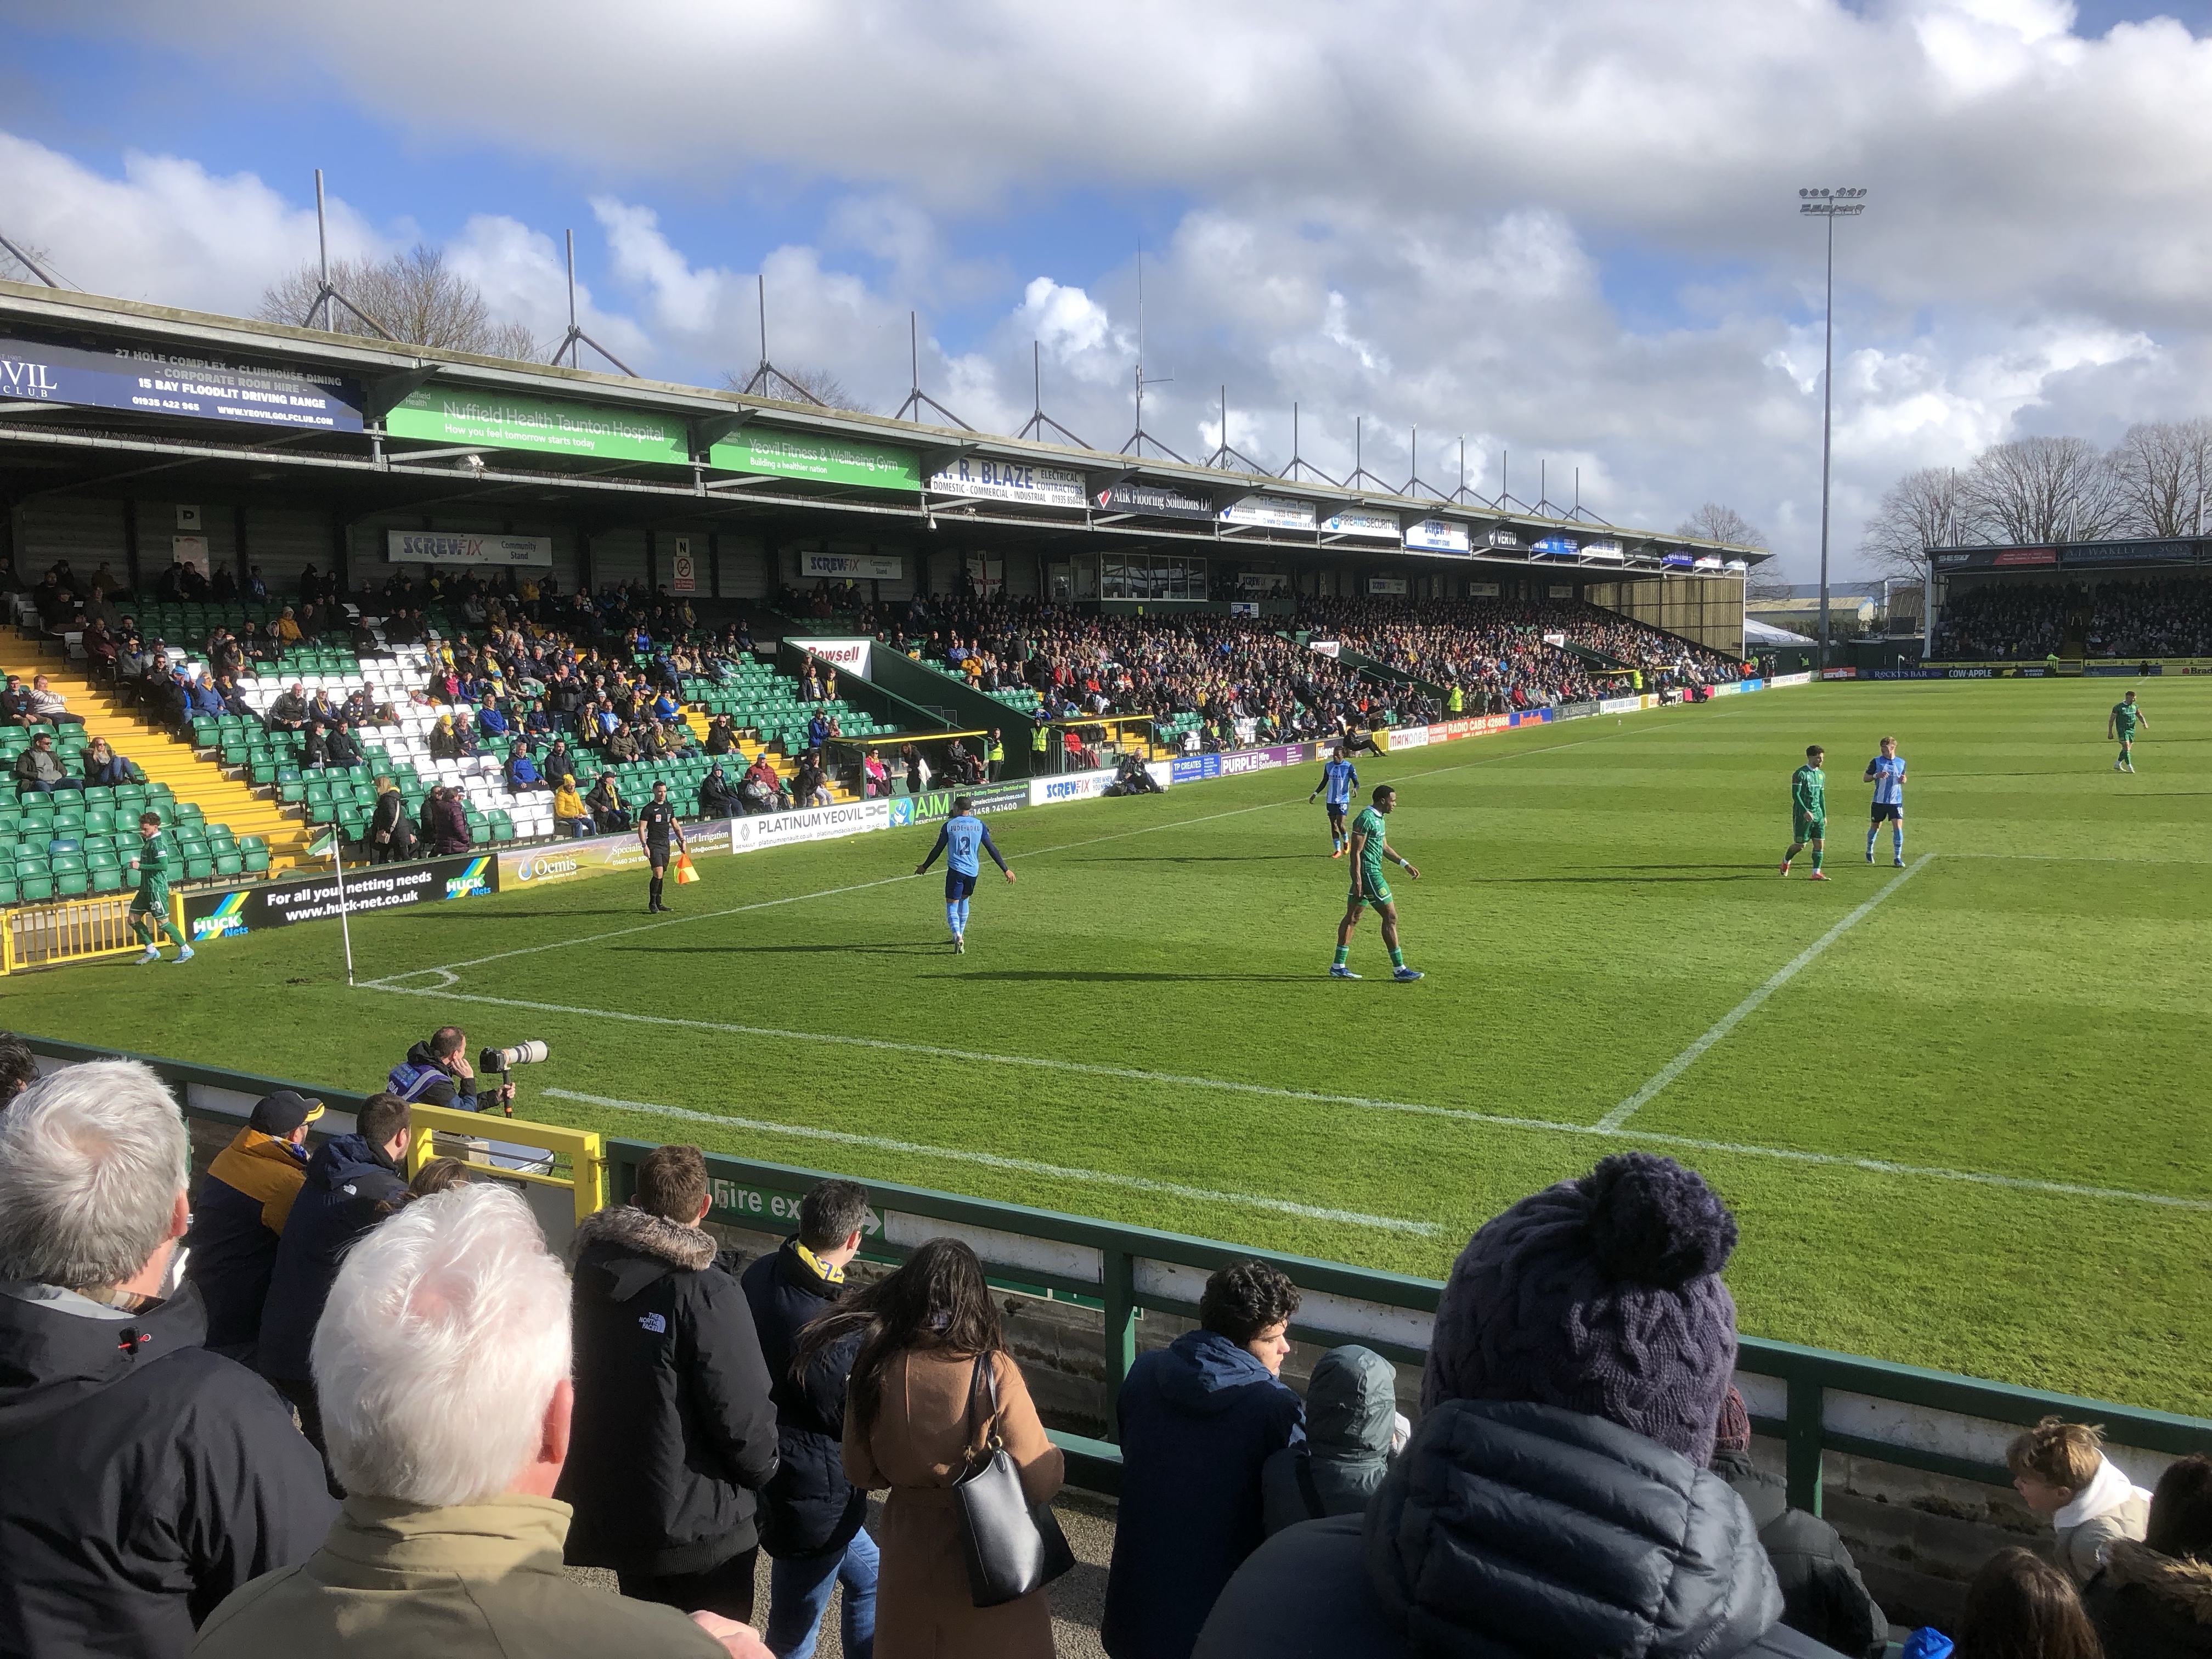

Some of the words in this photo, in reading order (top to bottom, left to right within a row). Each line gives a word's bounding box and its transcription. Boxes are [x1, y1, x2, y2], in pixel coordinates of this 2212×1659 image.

[0, 360, 57, 390] VIL
[115, 348, 129, 359] 27
[133, 351, 166, 364] HOLE
[170, 356, 227, 371] COMPLEX
[239, 365, 303, 381] CLUBHOUSE
[307, 374, 342, 386] DINING
[165, 368, 234, 385] CORPORATE
[238, 377, 270, 390] ROOM
[274, 382, 300, 393] HIRE
[3, 385, 48, 397] CLUB
[138, 377, 152, 388] 15
[155, 380, 178, 392] BAY
[182, 383, 239, 399] FLOODLIT
[242, 390, 287, 404] DRIVING
[290, 396, 326, 409] RANGE
[408, 391, 431, 400] uffield
[132, 396, 160, 407] 01935
[162, 400, 180, 409] 422
[182, 402, 199, 411] 965
[405, 397, 427, 407] Health
[217, 406, 334, 425] WWW.YEOVILGOLFCLUB.COM
[444, 400, 503, 424] Nuffield
[506, 408, 553, 429] Health
[556, 414, 610, 436] Taunton
[613, 421, 664, 443] Hospital
[445, 424, 466, 434] How
[468, 428, 484, 438] you
[487, 427, 502, 438] feel
[505, 431, 546, 442] tomorrow
[548, 435, 571, 445] starts
[572, 438, 595, 450] today
[749, 438, 780, 456] Yeovil
[782, 443, 817, 461] Fitness
[820, 448, 827, 462] &
[829, 449, 875, 471] Wellbeing
[877, 455, 898, 473] Gym
[750, 457, 775, 470] Building
[782, 460, 808, 471] healthier
[809, 465, 827, 473] nation
[960, 458, 975, 483] R.
[981, 461, 1033, 489] BLAZE
[1041, 469, 1078, 483] ELECTRICAL
[934, 481, 964, 493] DOMESTIC
[970, 486, 1008, 498] COMMERCIAL
[1014, 490, 1046, 502] INDUSTRIAL
[1052, 495, 1066, 504] 01935
[1036, 481, 1082, 494] CONTRACTORS
[1114, 488, 1131, 503] Atik
[1132, 489, 1164, 510] Flooring
[1166, 493, 1199, 511] Solutions
[1201, 498, 1212, 512] Ltd
[501, 540, 537, 552] Community
[1497, 530, 1516, 545] VERTU
[403, 537, 483, 558] SCREWFIX
[510, 551, 528, 560] Stand
[679, 542, 687, 552] N
[810, 556, 859, 573] SCREWFIX
[1605, 700, 1624, 709] SPARKFORD
[1626, 698, 1639, 707] STORAGE
[1448, 721, 1468, 735] RADIO
[1470, 719, 1486, 731] CABS
[1487, 716, 1509, 727] 426666
[1259, 753, 1269, 761] Hire
[1318, 746, 1334, 759] Higos
[1174, 763, 1180, 771] TP
[1181, 760, 1201, 770] CREATES
[1223, 755, 1257, 774] PURPLE
[1259, 759, 1282, 770] Solutions
[1047, 778, 1090, 799] SCREWFIX
[915, 793, 949, 819] AJM
[992, 802, 1017, 812] 241400
[759, 813, 821, 834] PLATINUM
[823, 808, 864, 825] YEOVIL
[612, 842, 644, 856] Specialis
[698, 831, 729, 843] Irrigation
[759, 833, 812, 847] platinumrenault.co.uk
[817, 825, 862, 837] platinumdacia.co.uk
[691, 843, 729, 853] info@ocmis.com
[960, 837, 970, 855] 2
[535, 856, 577, 876] Ocmis
[267, 894, 290, 906] For
[294, 889, 310, 901] all
[313, 885, 344, 901] your
[346, 878, 393, 894] netting
[396, 871, 432, 887] needs
[445, 877, 483, 893] HUCK
[472, 887, 491, 896] Nets
[149, 901, 161, 910] 20
[286, 890, 419, 921] www.huck-net.co.uk
[193, 915, 240, 933] HUCK
[224, 927, 249, 937] Nets
[714, 1178, 762, 1212] Fire
[771, 1194, 807, 1220] ex
[639, 1317, 658, 1325] NORTH
[642, 1323, 656, 1331] FACE
